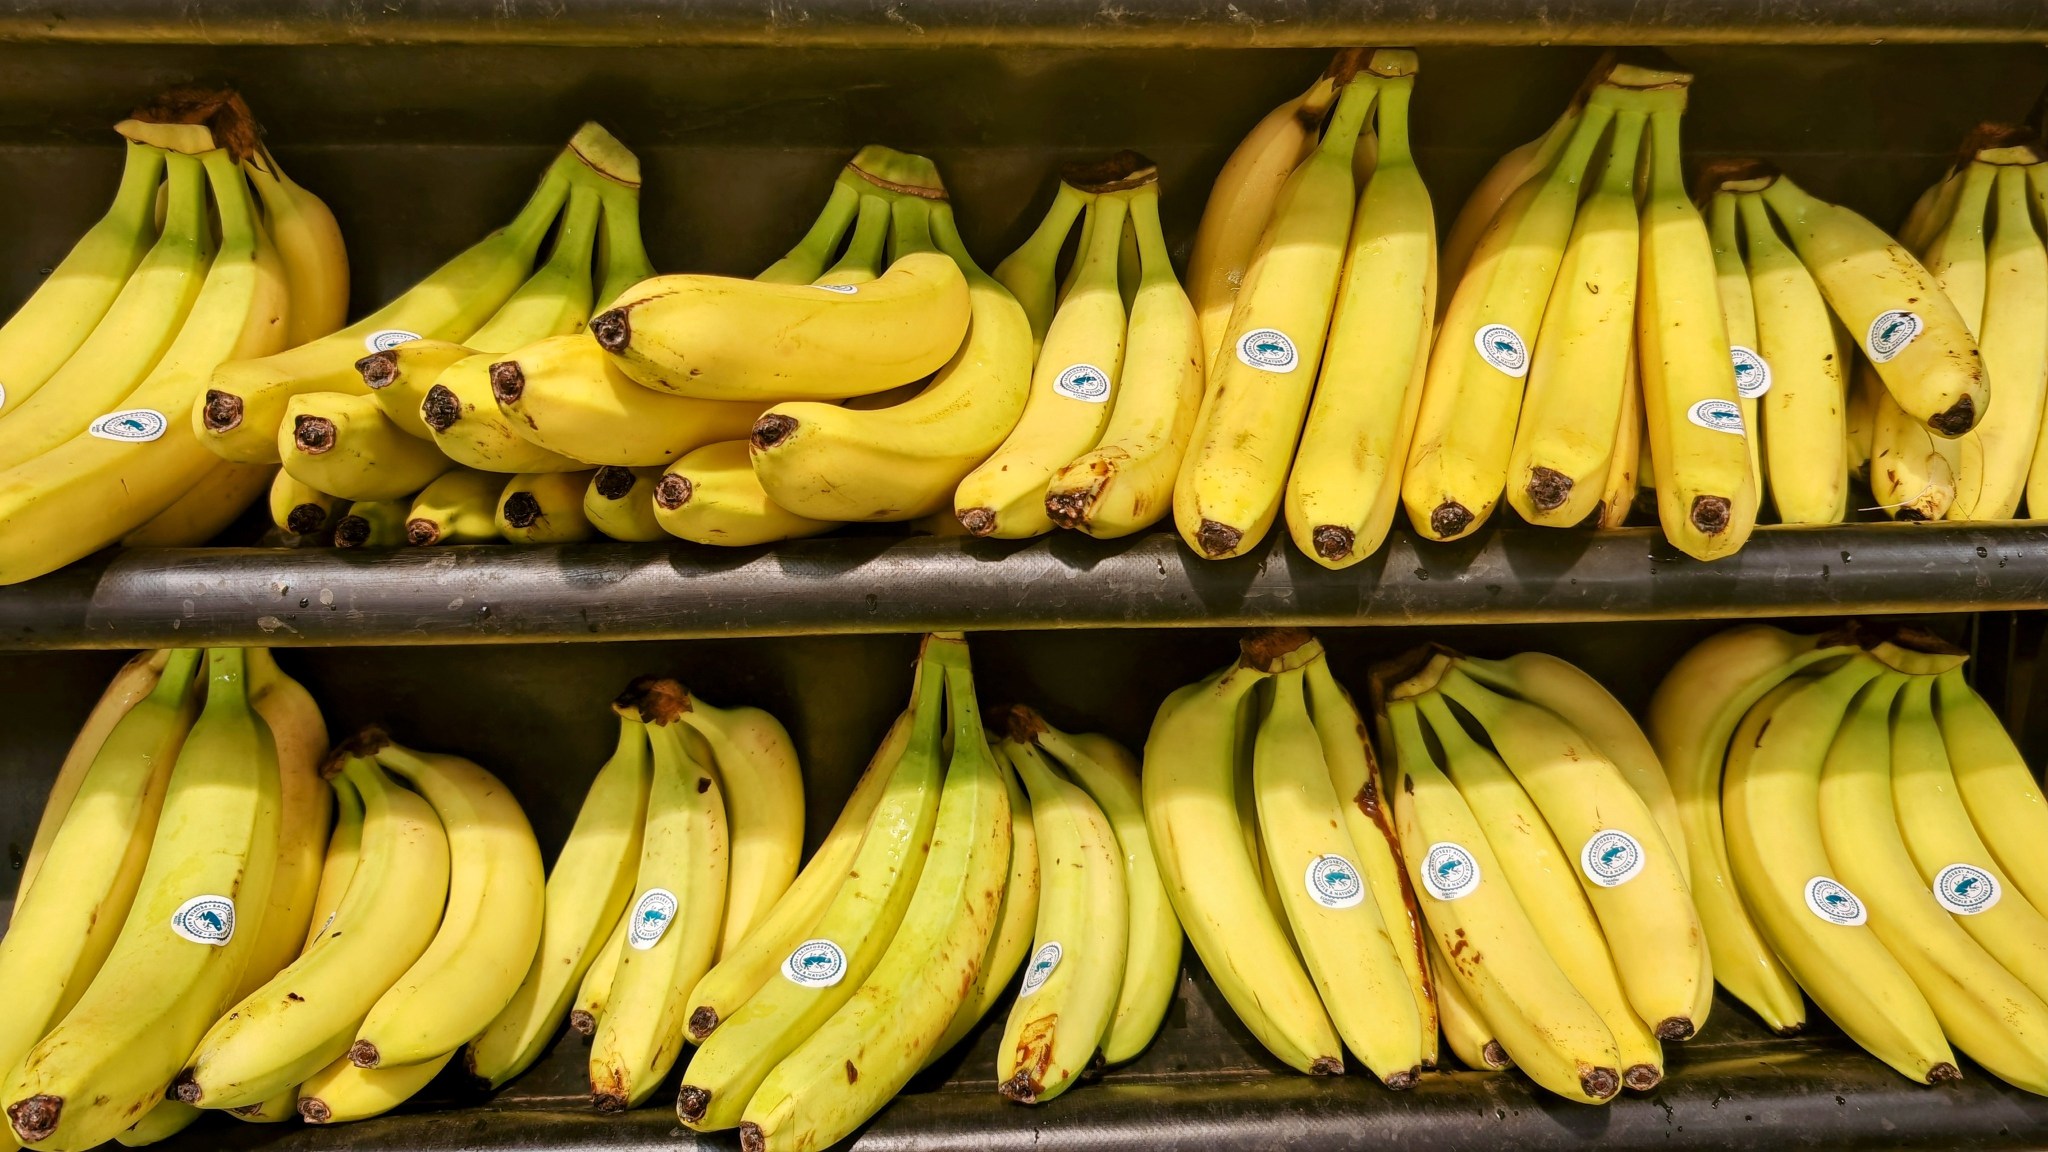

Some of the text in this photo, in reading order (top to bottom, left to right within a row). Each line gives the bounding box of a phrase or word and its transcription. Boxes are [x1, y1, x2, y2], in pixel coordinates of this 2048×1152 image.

[1592, 836, 1634, 858] RAINFOREST ALLIANCE
[1593, 861, 1609, 875] PEOPLE
[1944, 870, 1988, 891] RAINFOREST ALLIANCE
